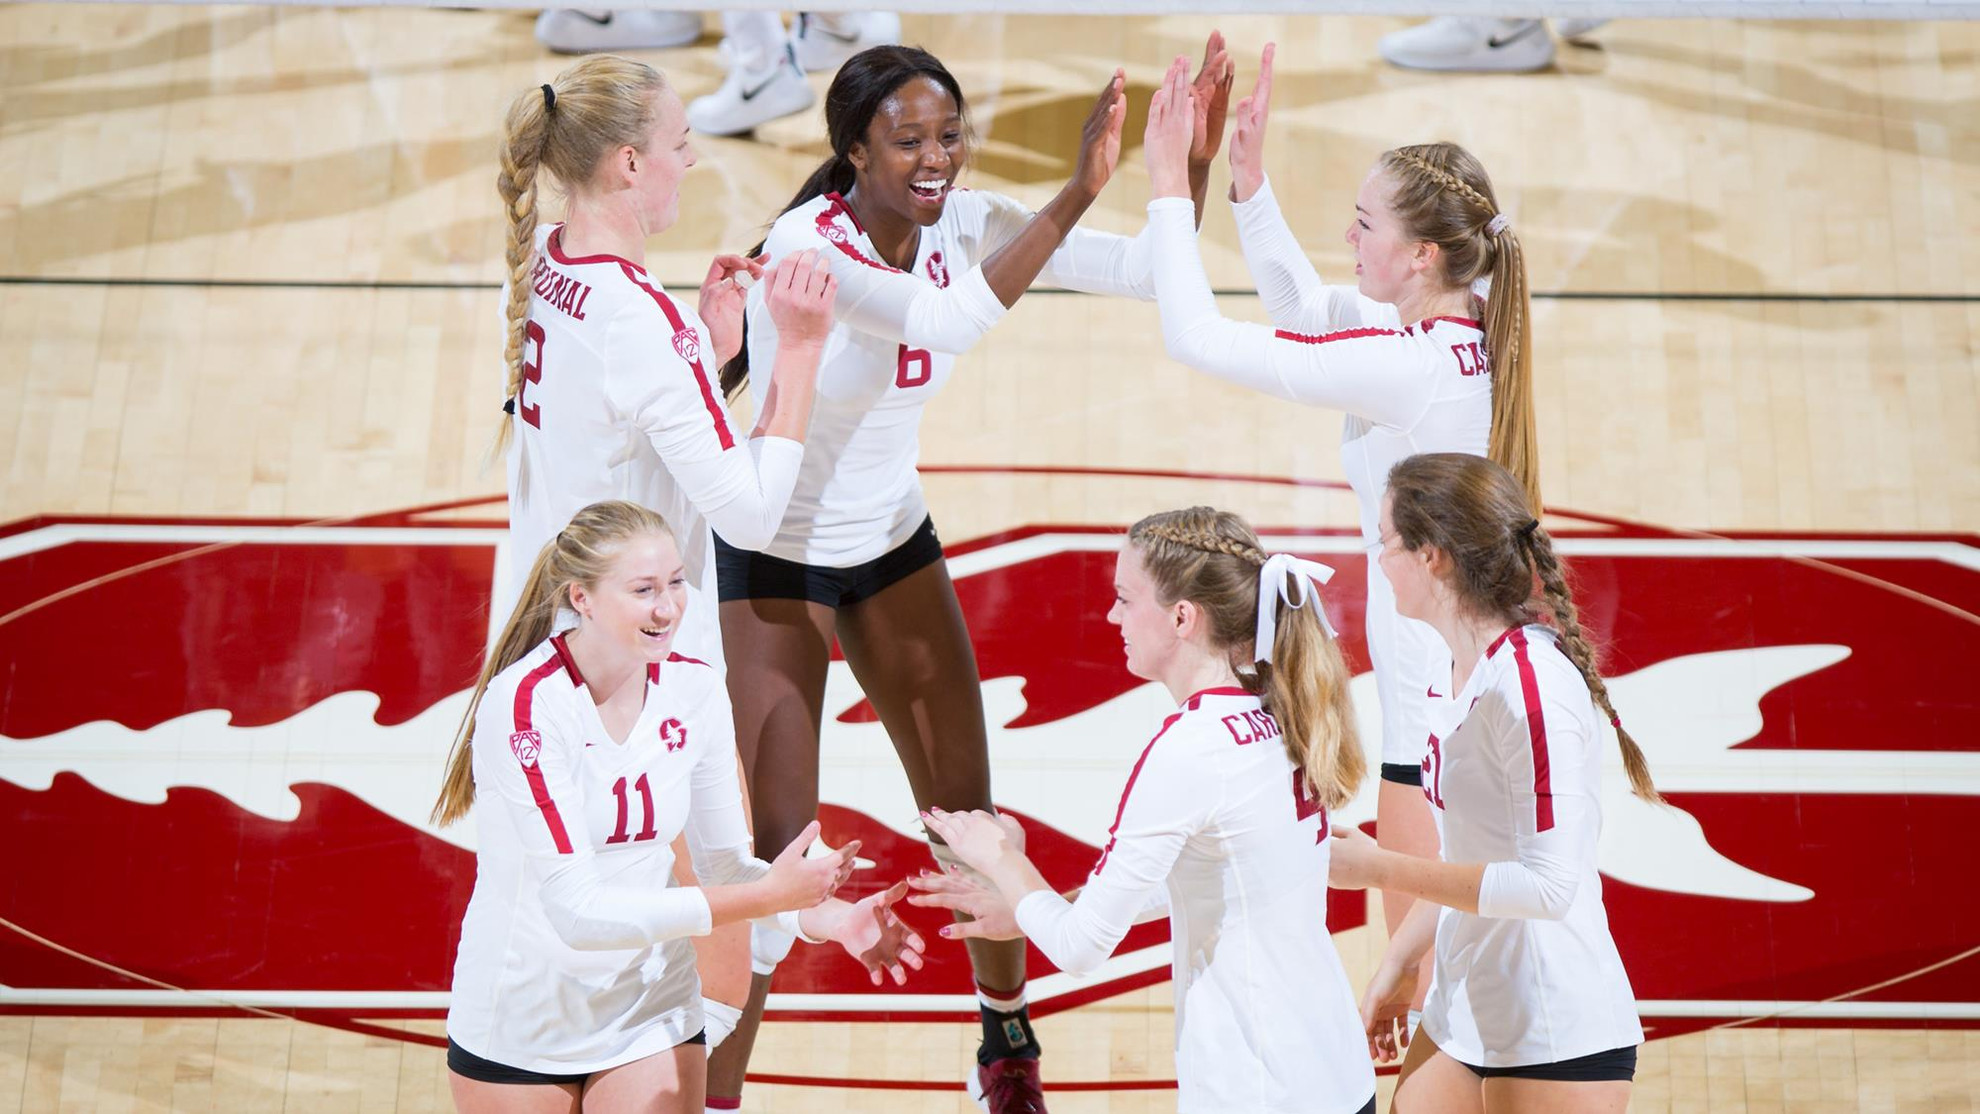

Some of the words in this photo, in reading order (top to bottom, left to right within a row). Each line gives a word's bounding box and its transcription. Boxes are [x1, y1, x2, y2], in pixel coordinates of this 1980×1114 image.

[684, 343, 698, 358] 12
[895, 343, 932, 388] 6
[520, 319, 546, 431] 2
[1221, 708, 1283, 746] CAR
[520, 745, 536, 760] 12
[605, 772, 658, 844] 11
[1293, 766, 1329, 846] 4
